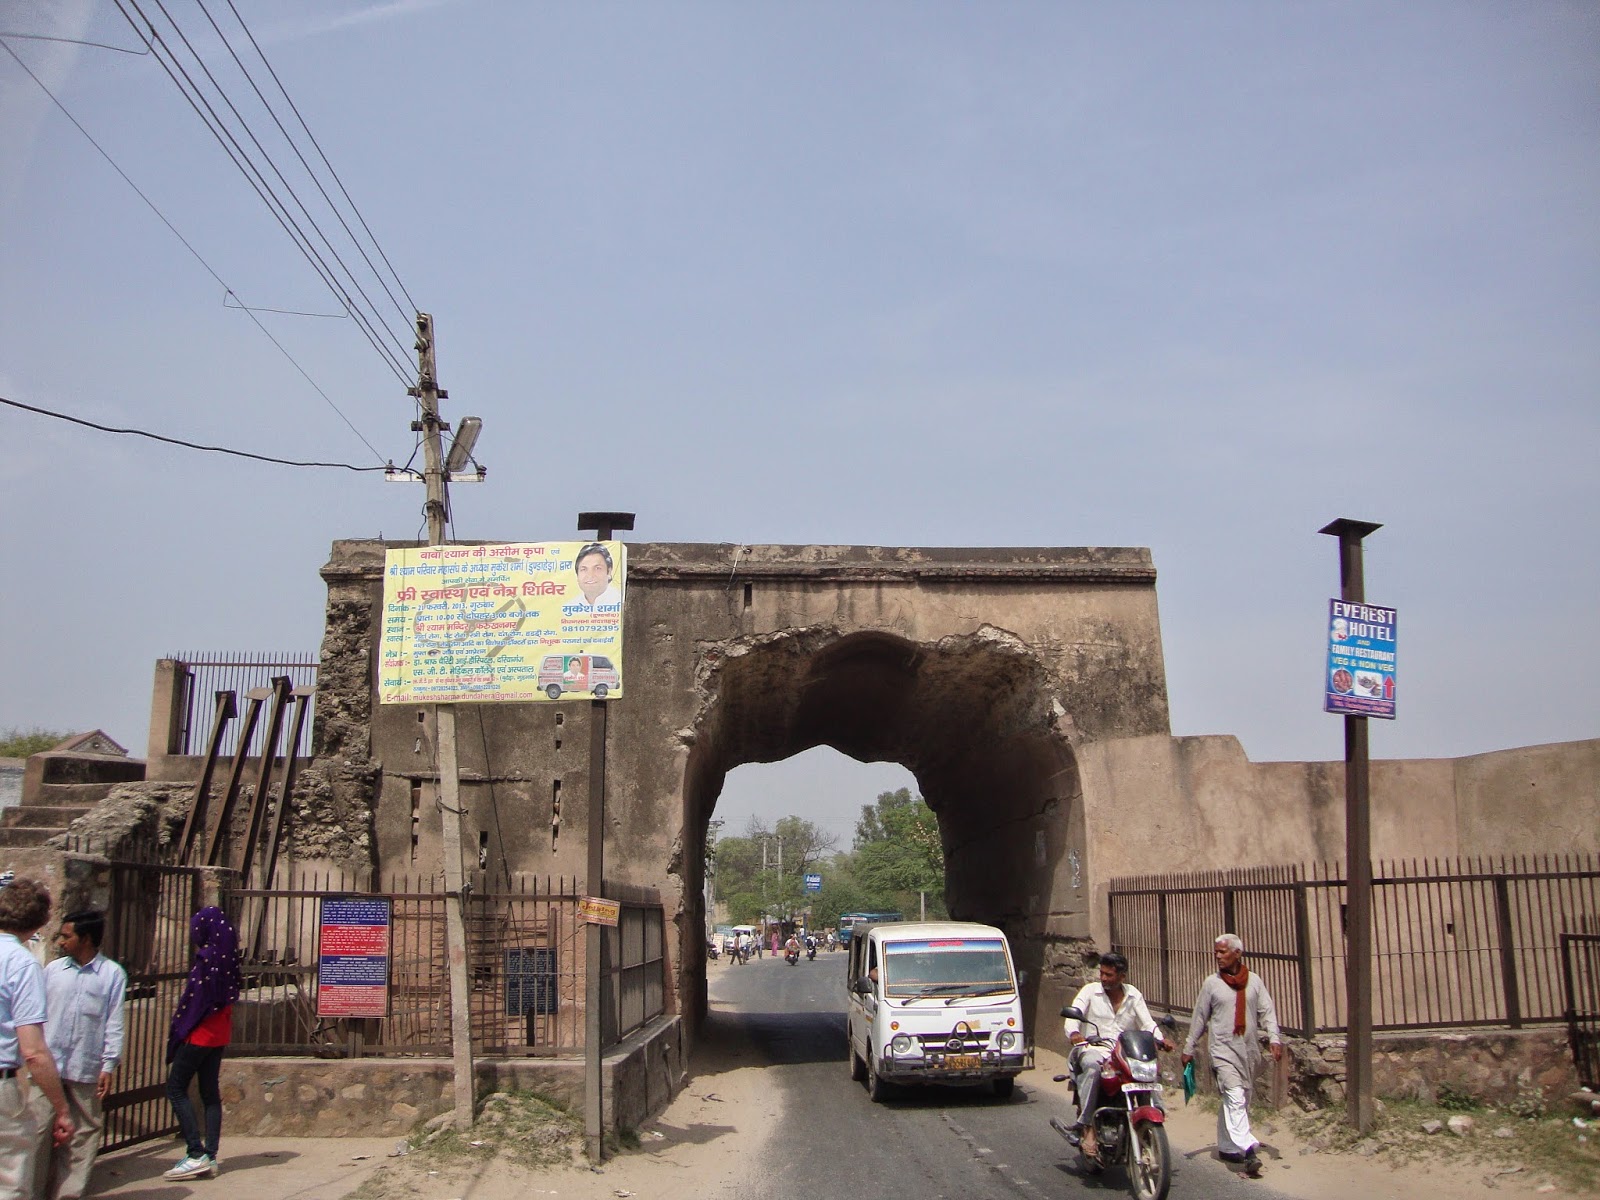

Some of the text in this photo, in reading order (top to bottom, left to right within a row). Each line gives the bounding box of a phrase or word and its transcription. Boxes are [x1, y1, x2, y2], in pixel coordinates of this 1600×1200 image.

[444, 549, 469, 558] श्याम
[473, 547, 486, 558] की
[489, 546, 520, 557] असीम
[523, 547, 544, 558] कृपा
[389, 564, 398, 576] श्री
[400, 566, 415, 576] श्याम
[417, 563, 436, 575] परिवार
[461, 562, 468, 573] के
[491, 561, 508, 576] मुकेश
[510, 559, 524, 571] शर्मा
[559, 560, 572, 571] द्वारा
[397, 586, 417, 604] फ्री
[469, 584, 491, 598] एवं
[493, 583, 517, 597] नेत्र
[522, 581, 566, 597] शिविर
[387, 615, 406, 624] समय
[525, 610, 540, 618] तक
[562, 601, 621, 617] मुकेश शर्मा
[1333, 602, 1396, 624] EVEREST
[415, 622, 425, 632] श्री
[427, 623, 445, 632] श्याम
[1349, 621, 1395, 642] HOTEL
[1332, 644, 1394, 661] FAMILY RESTAURANT
[1332, 656, 1348, 666] VEG
